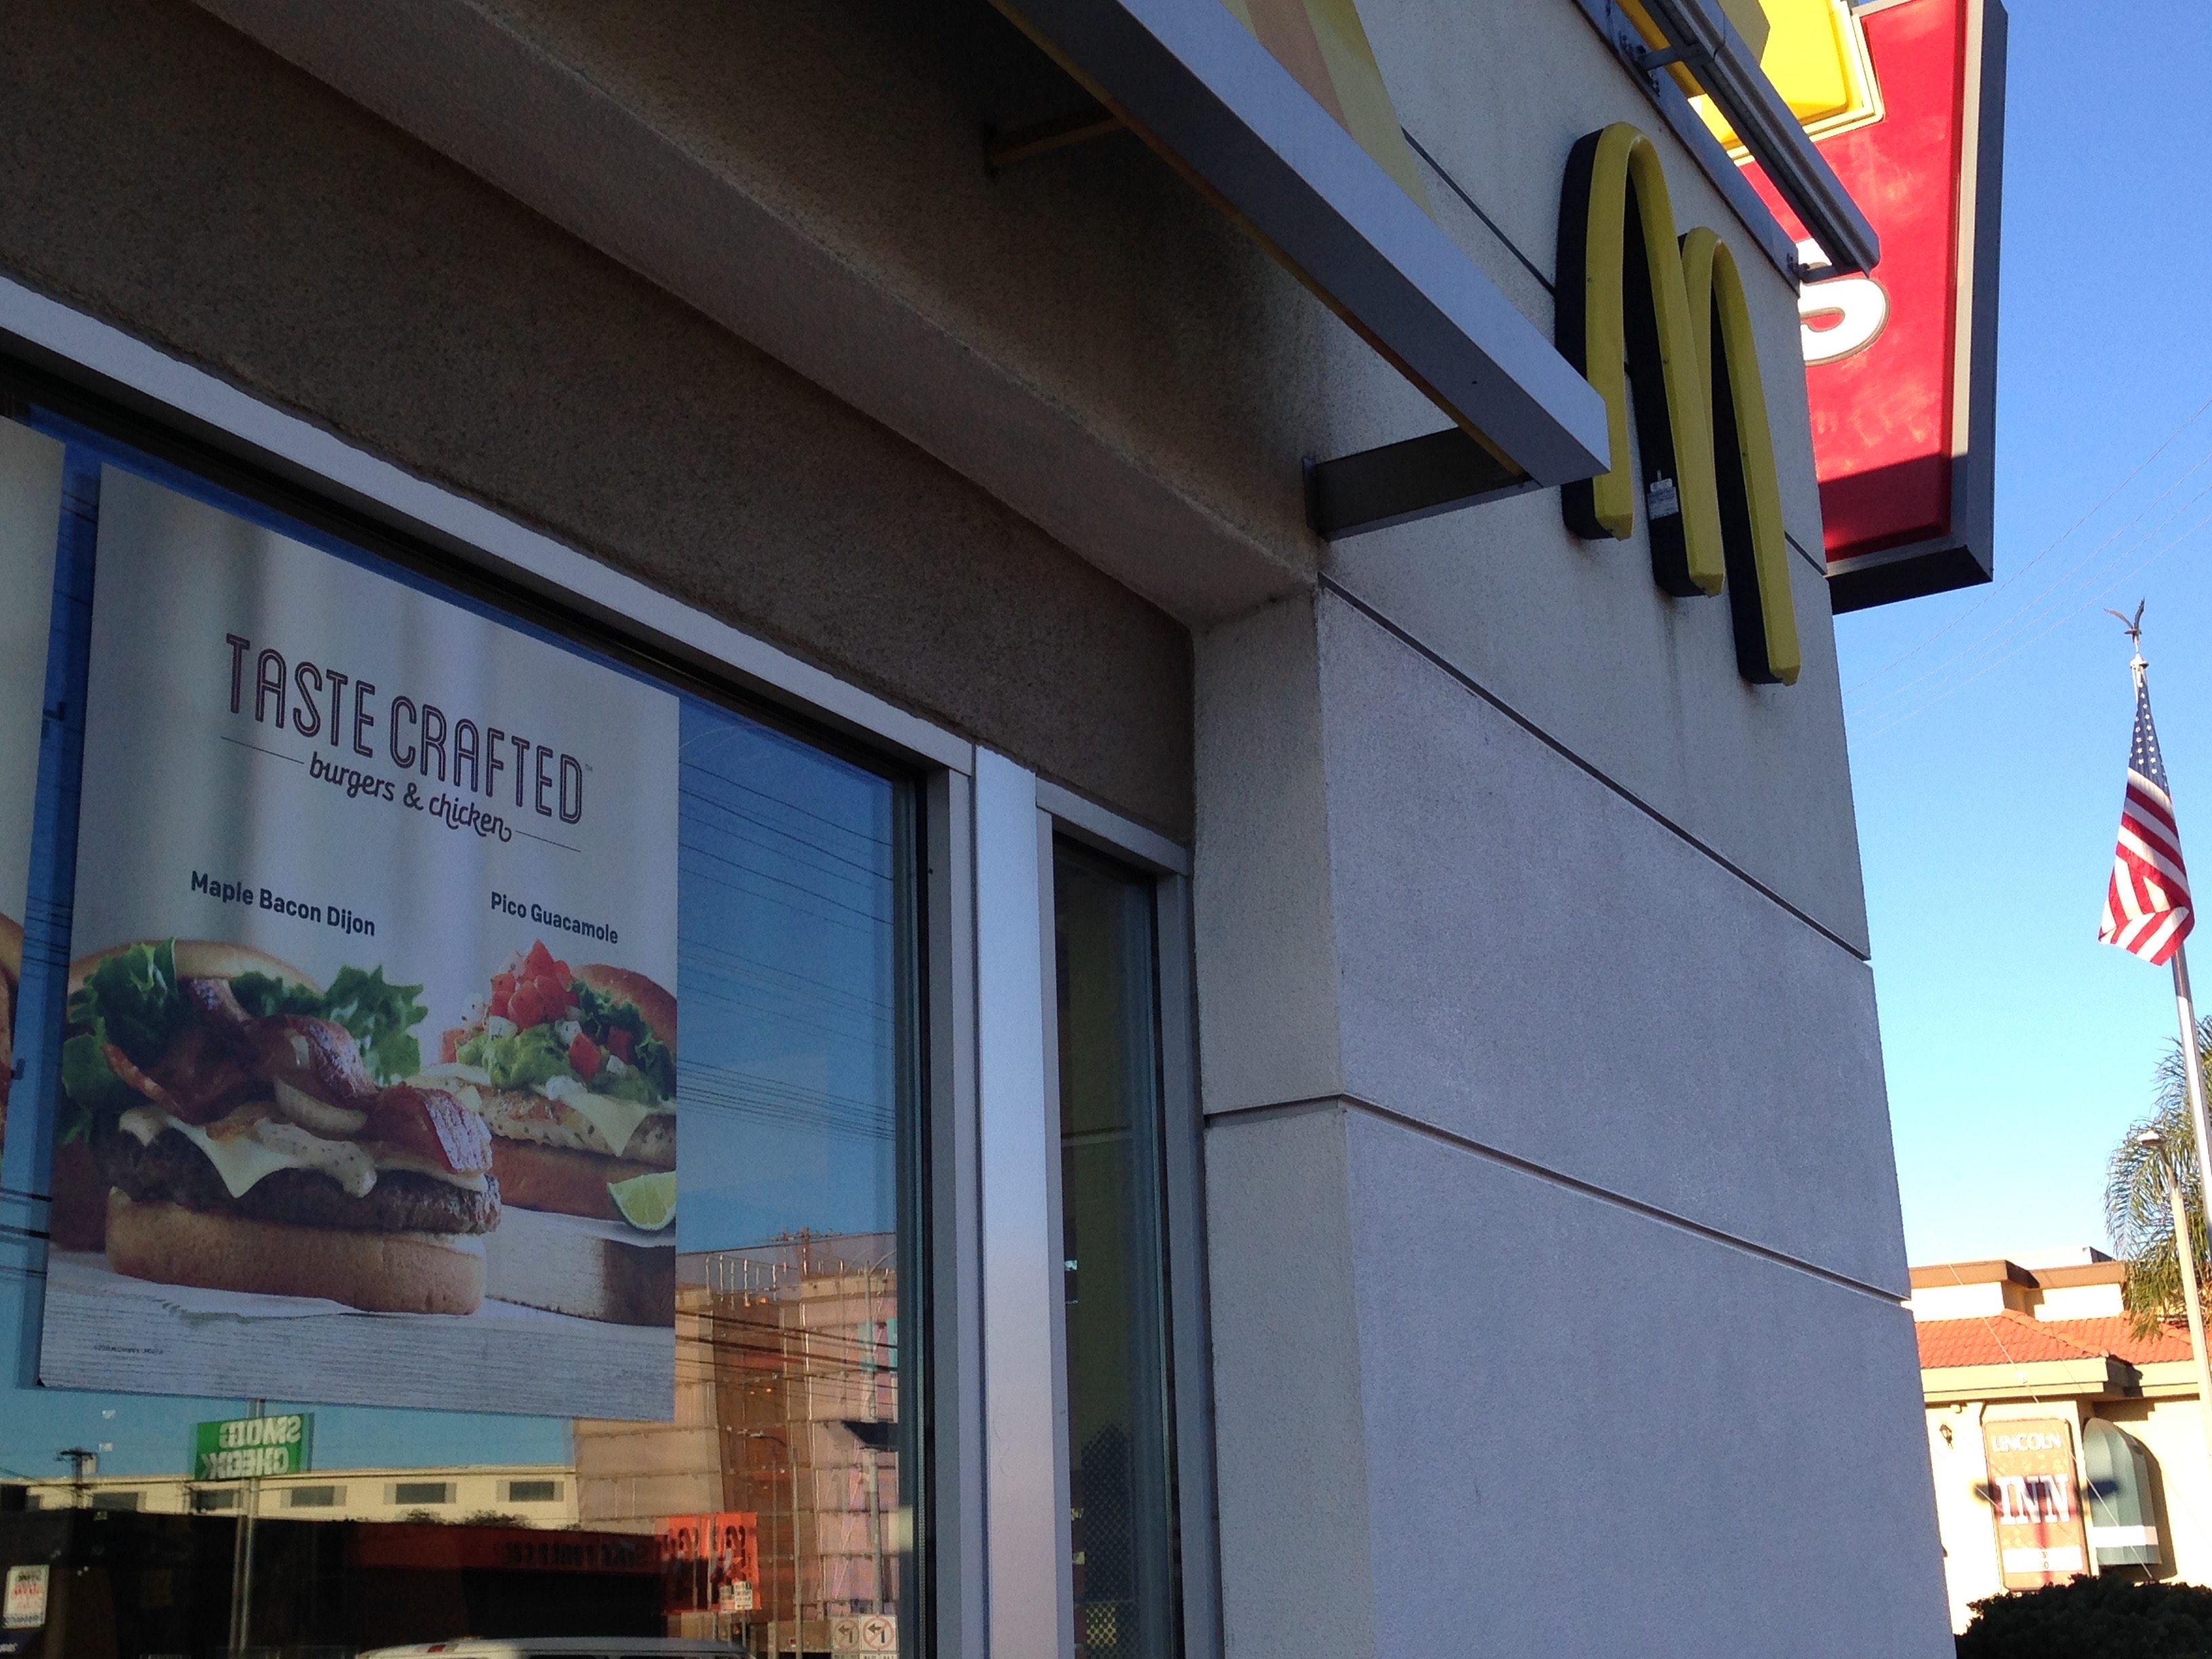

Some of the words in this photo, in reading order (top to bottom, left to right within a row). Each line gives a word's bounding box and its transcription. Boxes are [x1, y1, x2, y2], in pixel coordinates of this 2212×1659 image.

[226, 633, 375, 758] TASTE
[390, 695, 583, 825] CRAFTED
[309, 752, 395, 798] burgers
[403, 782, 424, 811] &
[429, 793, 512, 842] chicken
[191, 870, 254, 905] Maple
[260, 888, 322, 923] Bacon
[327, 905, 375, 936] Dijon
[491, 891, 527, 919] Pico
[531, 904, 619, 944] Guacamole
[1991, 1433, 2062, 1453] LINCOLN
[1994, 1473, 2070, 1525] INN
